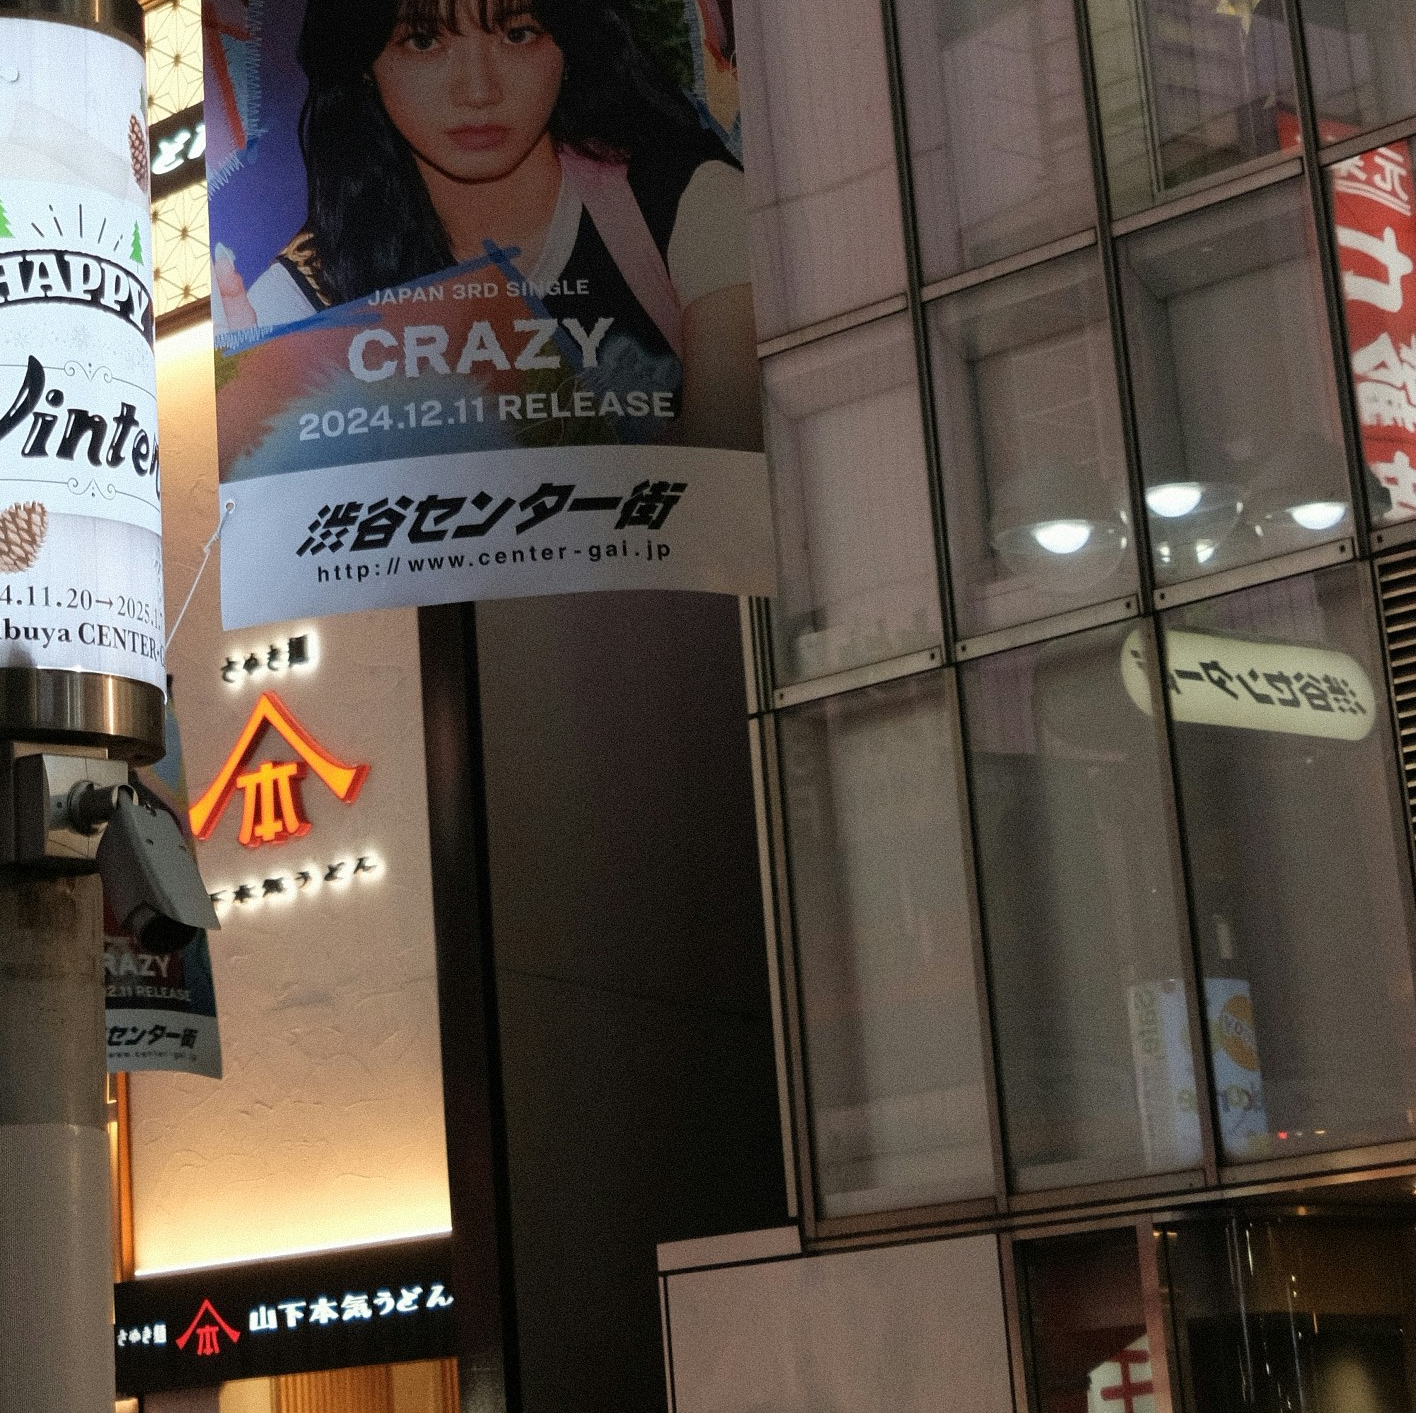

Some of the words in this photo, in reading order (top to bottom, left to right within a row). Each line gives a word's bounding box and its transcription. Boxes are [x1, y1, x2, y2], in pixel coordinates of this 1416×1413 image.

[367, 284, 445, 307] JAPAN
[451, 280, 499, 301] 3RD
[505, 278, 590, 298] SINGLE
[347, 316, 615, 384] CRAZY
[299, 396, 485, 442] 2024.12.11
[498, 390, 675, 423] RELEASE
[295, 478, 688, 558] 渋谷センター街
[317, 540, 673, 584] http://www.center-gai.jp
[135, 986, 192, 1002] RELEASE
[249, 1283, 455, 1333] 山下本気うどん
